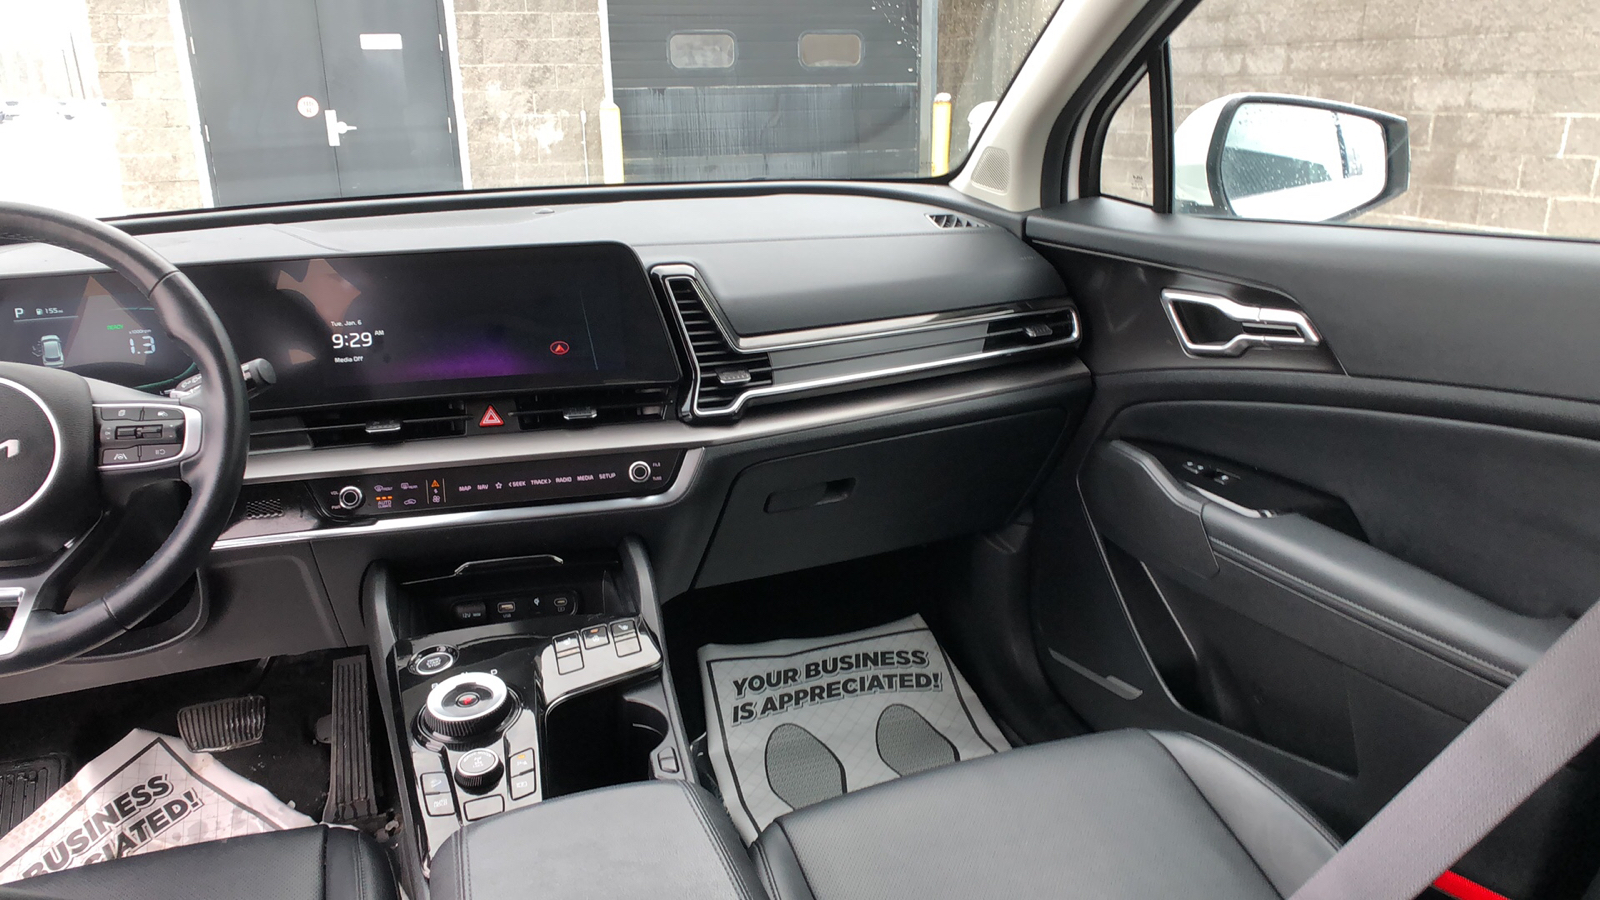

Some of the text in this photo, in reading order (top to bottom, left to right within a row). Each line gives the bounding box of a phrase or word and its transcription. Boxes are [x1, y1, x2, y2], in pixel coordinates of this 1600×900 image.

[15, 308, 24, 318] P
[129, 335, 156, 354] 1.3
[331, 332, 373, 349] 9:29
[733, 650, 928, 697] YOUR BUSINESS
[732, 672, 942, 724] IS APPRECIATED!
